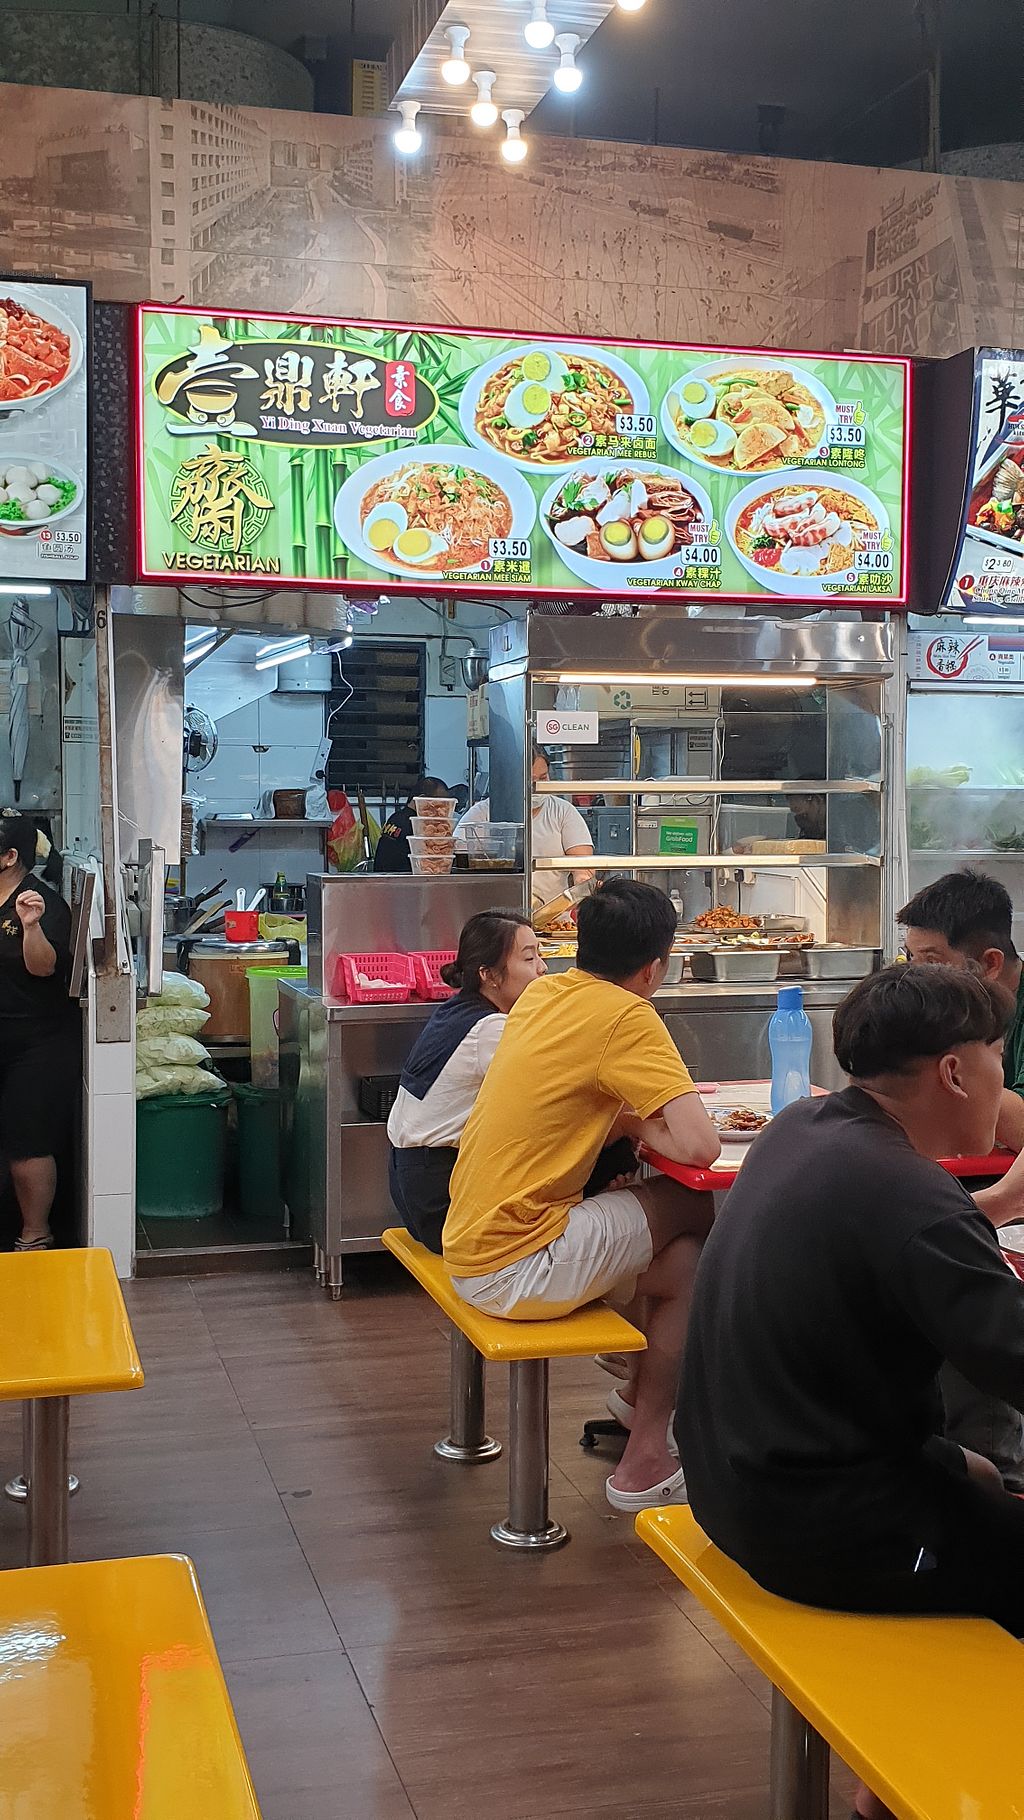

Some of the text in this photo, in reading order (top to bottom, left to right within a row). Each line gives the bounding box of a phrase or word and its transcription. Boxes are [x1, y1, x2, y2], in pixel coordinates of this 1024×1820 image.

[388, 364, 412, 412] 素食
[836, 405, 854, 413] MUST
[620, 416, 653, 432] $3.50
[840, 415, 853, 423] TRY
[260, 416, 417, 438] Yi Ding Xuan Vegetarian
[830, 426, 862, 442] $3.50
[595, 434, 656, 449] 素马来卤面
[567, 447, 657, 459] VEGETARIAN MEE REBUS
[782, 457, 865, 468] VEGETARIAN LONTONG
[690, 524, 709, 532] MUST
[56, 532, 79, 542] $3.50
[694, 534, 708, 543] TRY
[863, 532, 881, 540] MUST
[493, 540, 527, 556] $3.50
[867, 541, 880, 550] TRY
[685, 548, 718, 563] $4.00
[858, 553, 889, 568] $4.00
[162, 551, 280, 573] VEGETARIAN
[443, 571, 531, 583] VEGETARIAN MEE SIAM
[627, 578, 674, 587] VEGETARIAN
[676, 580, 698, 588] KWAY
[822, 583, 892, 593] VEGETARIAN LAKSA
[96, 610, 107, 629] 6
